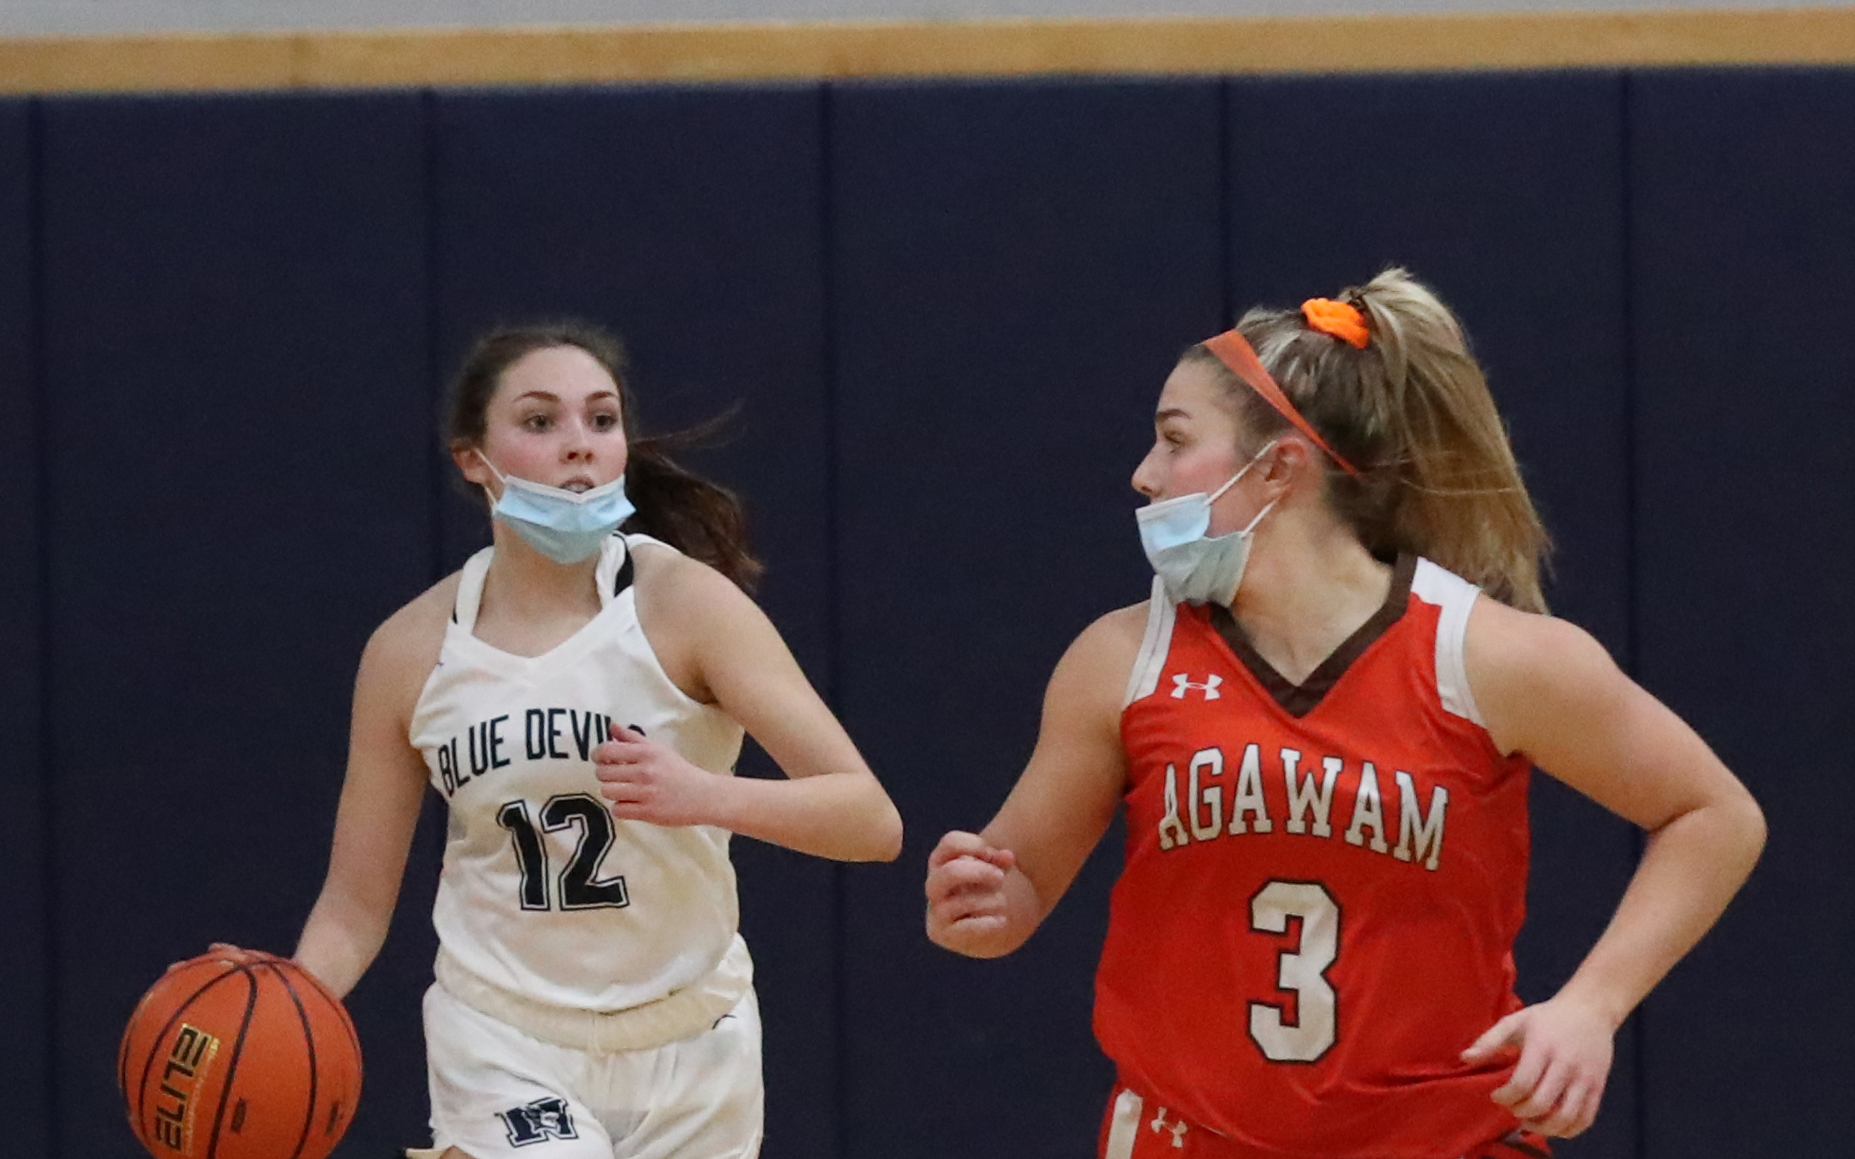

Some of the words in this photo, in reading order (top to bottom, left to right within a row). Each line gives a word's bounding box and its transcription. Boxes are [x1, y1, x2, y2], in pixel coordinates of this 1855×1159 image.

[438, 714, 511, 797] BLUE
[1158, 743, 1449, 871] AGAWAM
[497, 791, 630, 912] 12
[1248, 877, 1342, 1065] 3
